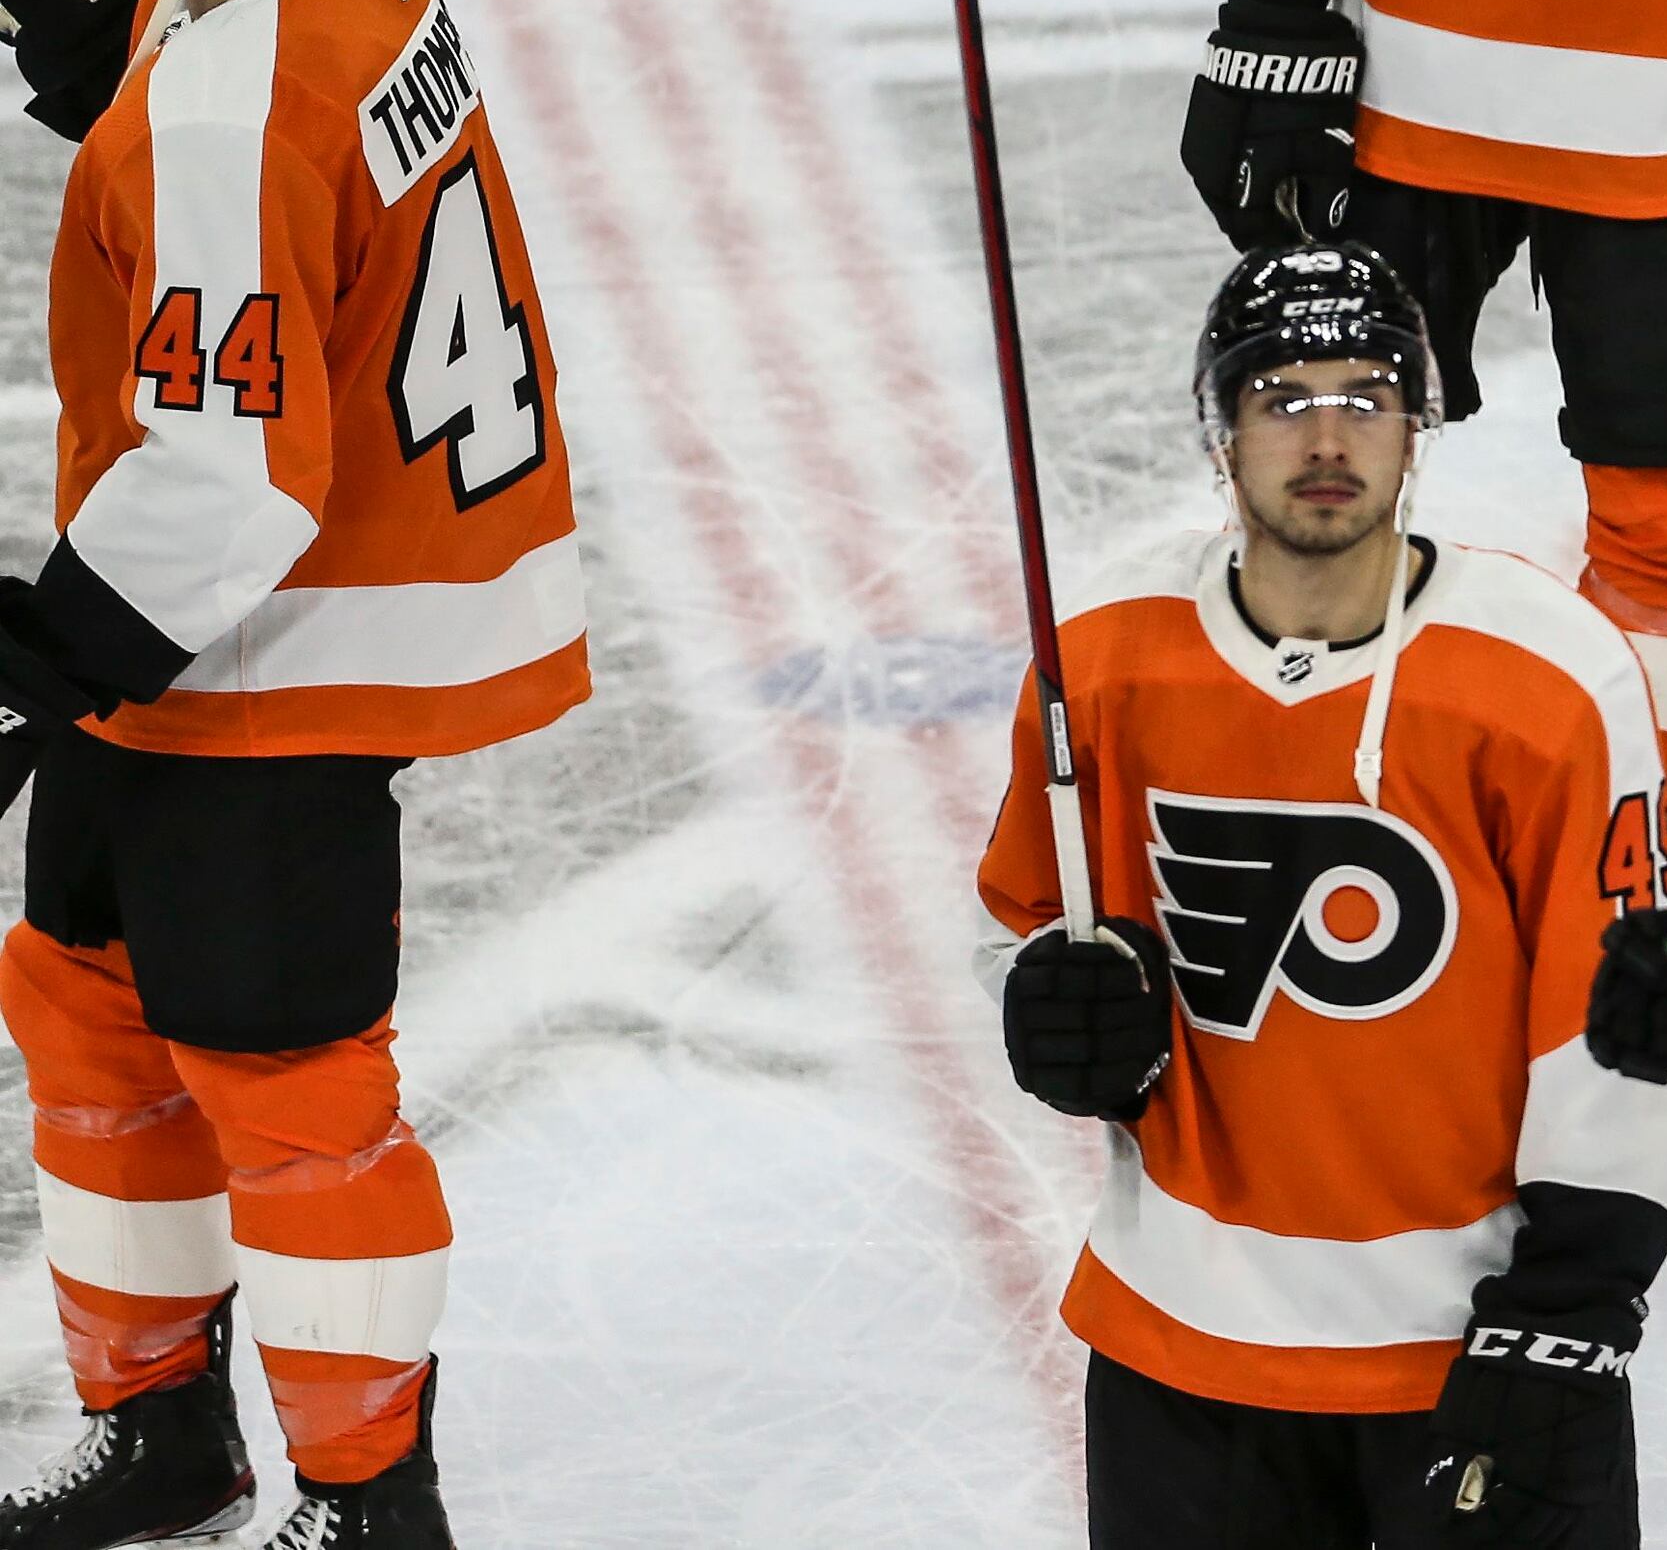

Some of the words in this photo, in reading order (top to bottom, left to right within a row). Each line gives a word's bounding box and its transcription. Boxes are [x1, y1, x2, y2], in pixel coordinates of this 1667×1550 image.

[1205, 44, 1358, 95] ARRIOR
[1282, 297, 1364, 318] CCM
[134, 286, 284, 418] 44
[1468, 1327, 1634, 1378] CCM
